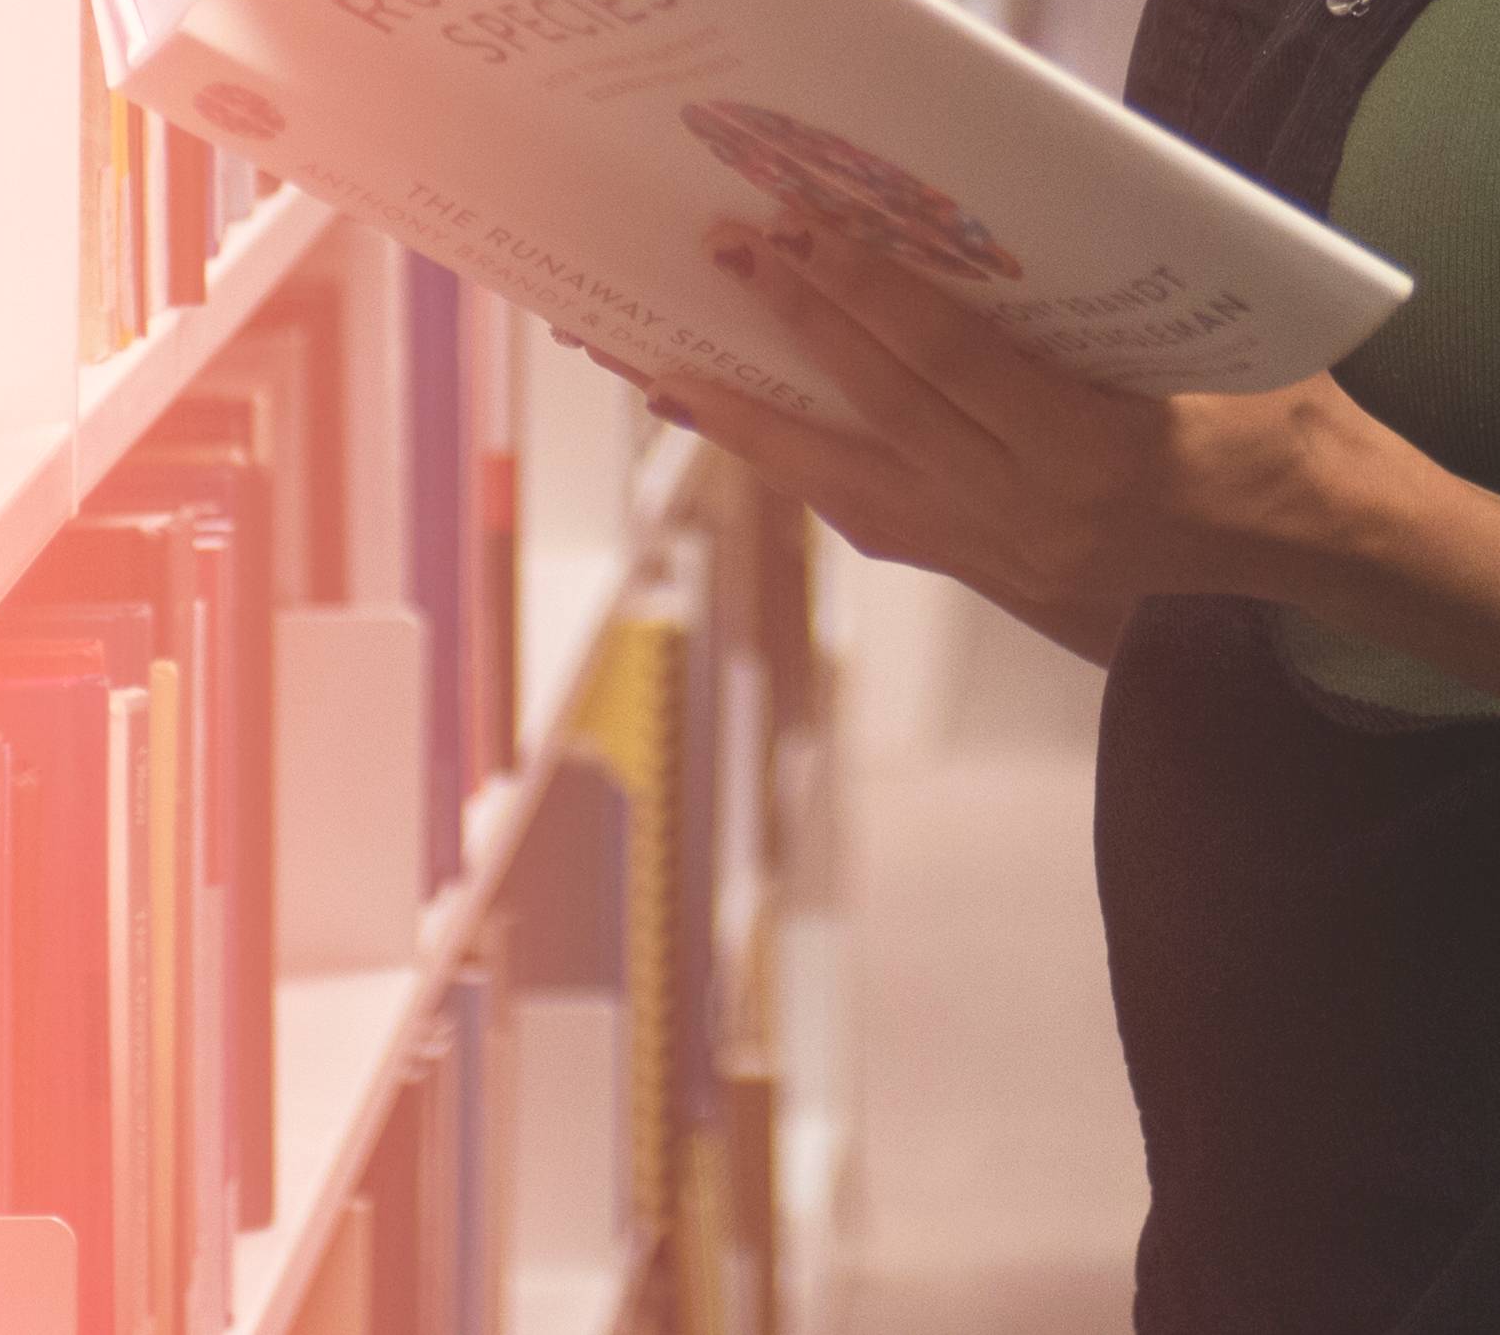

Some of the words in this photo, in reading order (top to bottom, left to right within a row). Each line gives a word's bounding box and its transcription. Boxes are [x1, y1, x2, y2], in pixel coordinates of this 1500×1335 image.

[301, 161, 450, 248] ANTHONY
[580, 311, 601, 328] &
[407, 181, 479, 230] THE
[486, 225, 666, 329] RUNAWAY
[668, 327, 816, 411] SPECIES
